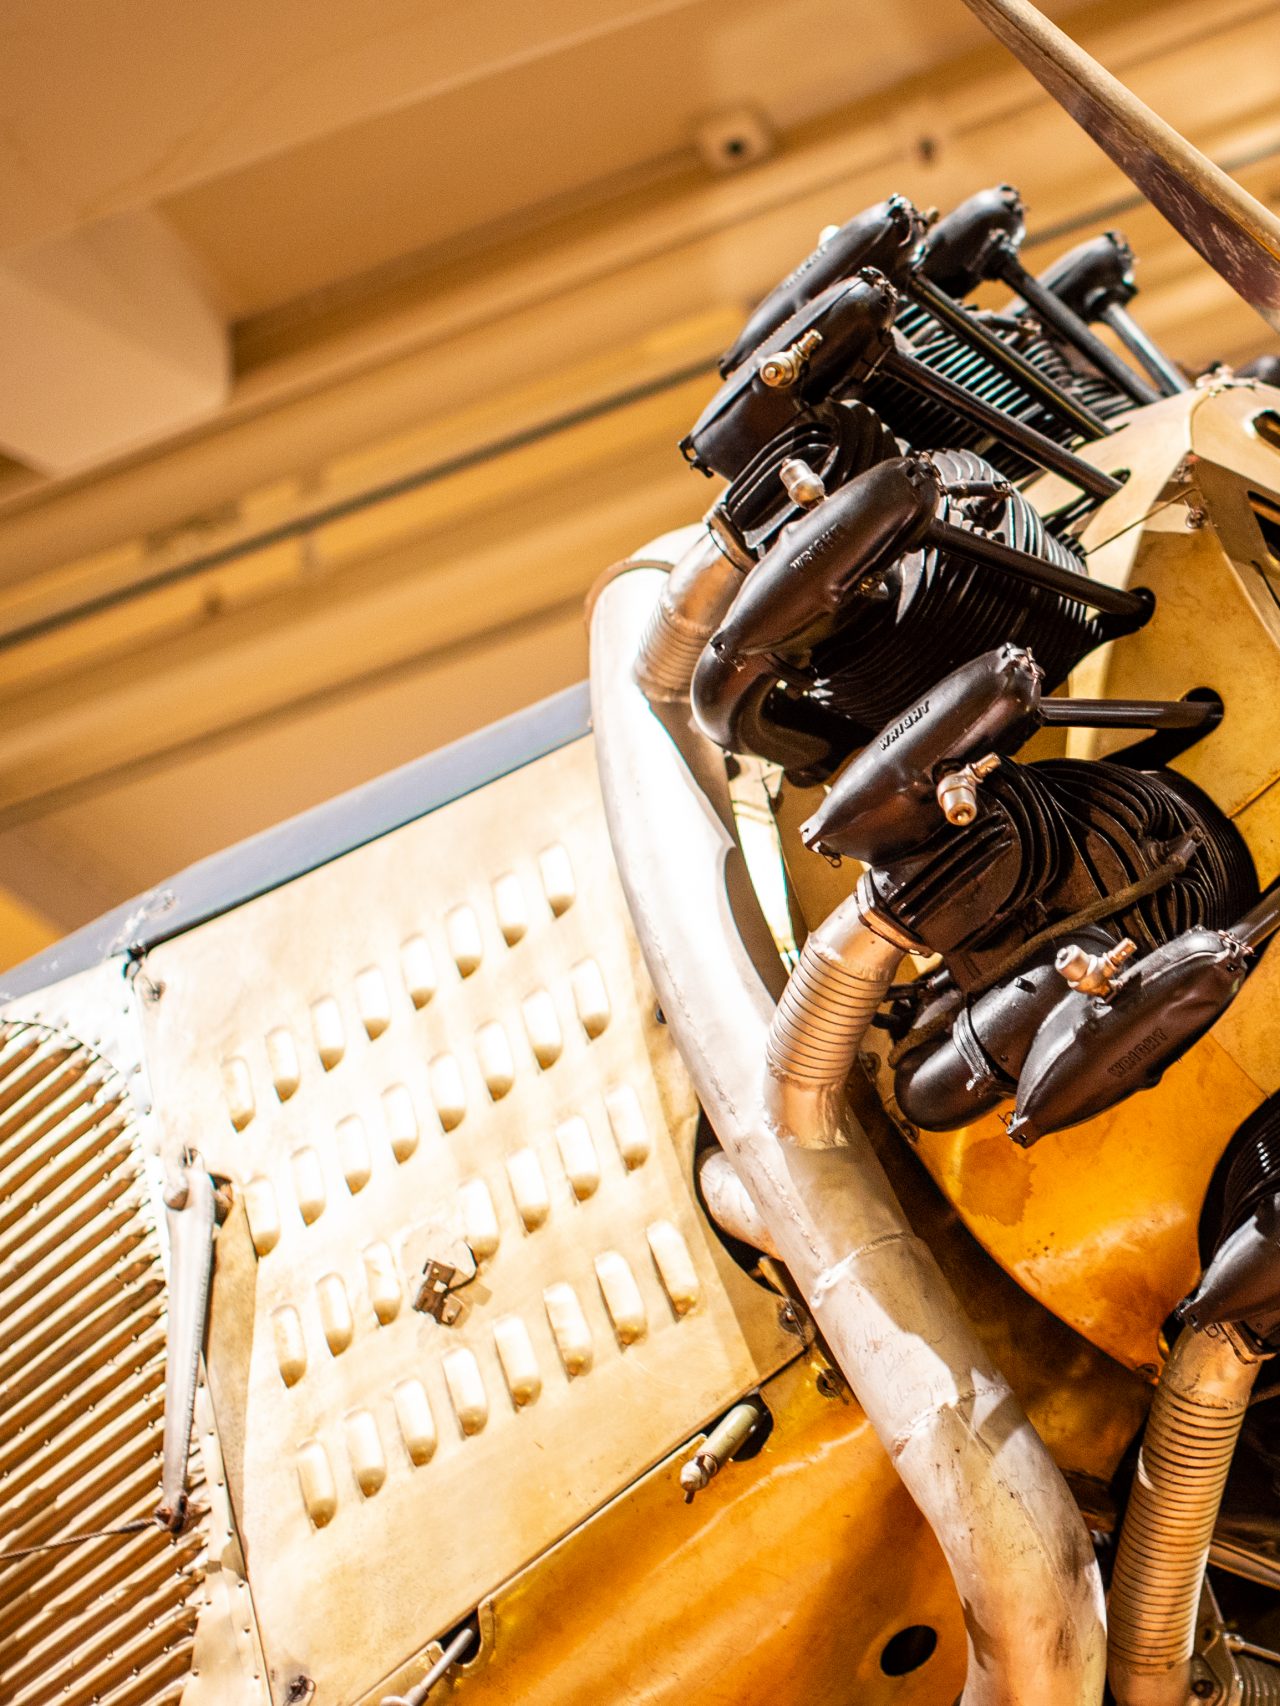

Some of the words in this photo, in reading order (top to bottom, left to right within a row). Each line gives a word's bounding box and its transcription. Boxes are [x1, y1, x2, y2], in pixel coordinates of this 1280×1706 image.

[789, 523, 838, 569] WRIGHT
[879, 700, 930, 751] WRIGHT
[1107, 1027, 1168, 1078] WRIGHT
